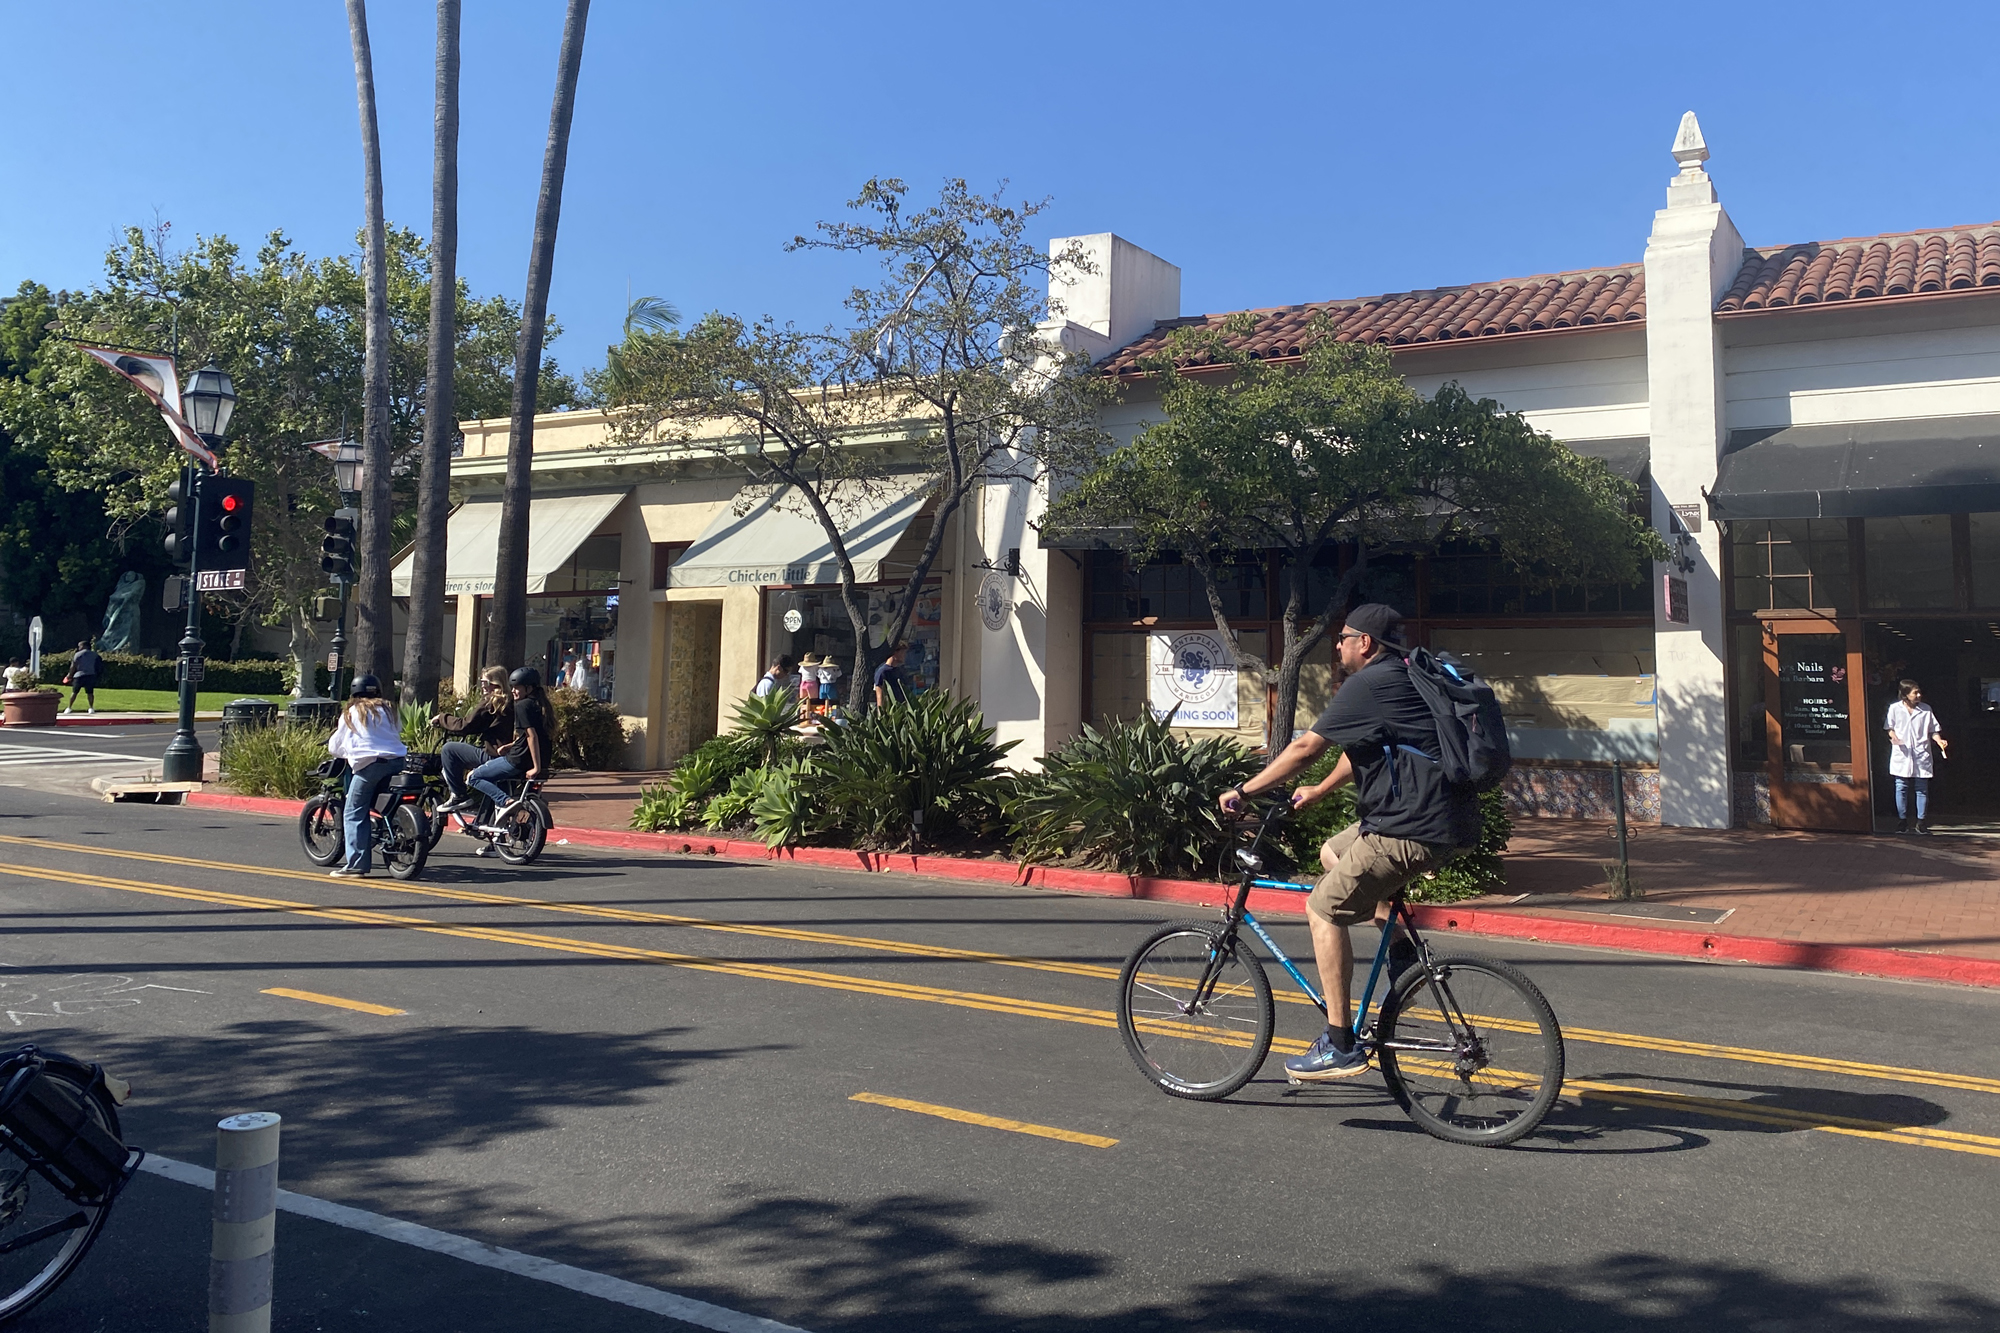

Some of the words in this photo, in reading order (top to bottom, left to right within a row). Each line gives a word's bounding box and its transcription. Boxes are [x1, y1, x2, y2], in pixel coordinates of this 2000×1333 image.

[203, 573, 231, 588] STATE
[728, 569, 777, 582] Chicken
[782, 568, 811, 581] Little
[783, 616, 802, 624] OPEN
[1171, 636, 1194, 655] SANTA
[1196, 636, 1220, 656] PLAYA
[1797, 662, 1824, 672] Nails
[1173, 686, 1216, 701] MARISCOS
[1202, 710, 1235, 721] SOON
[1249, 921, 1288, 962] RALEIGH
